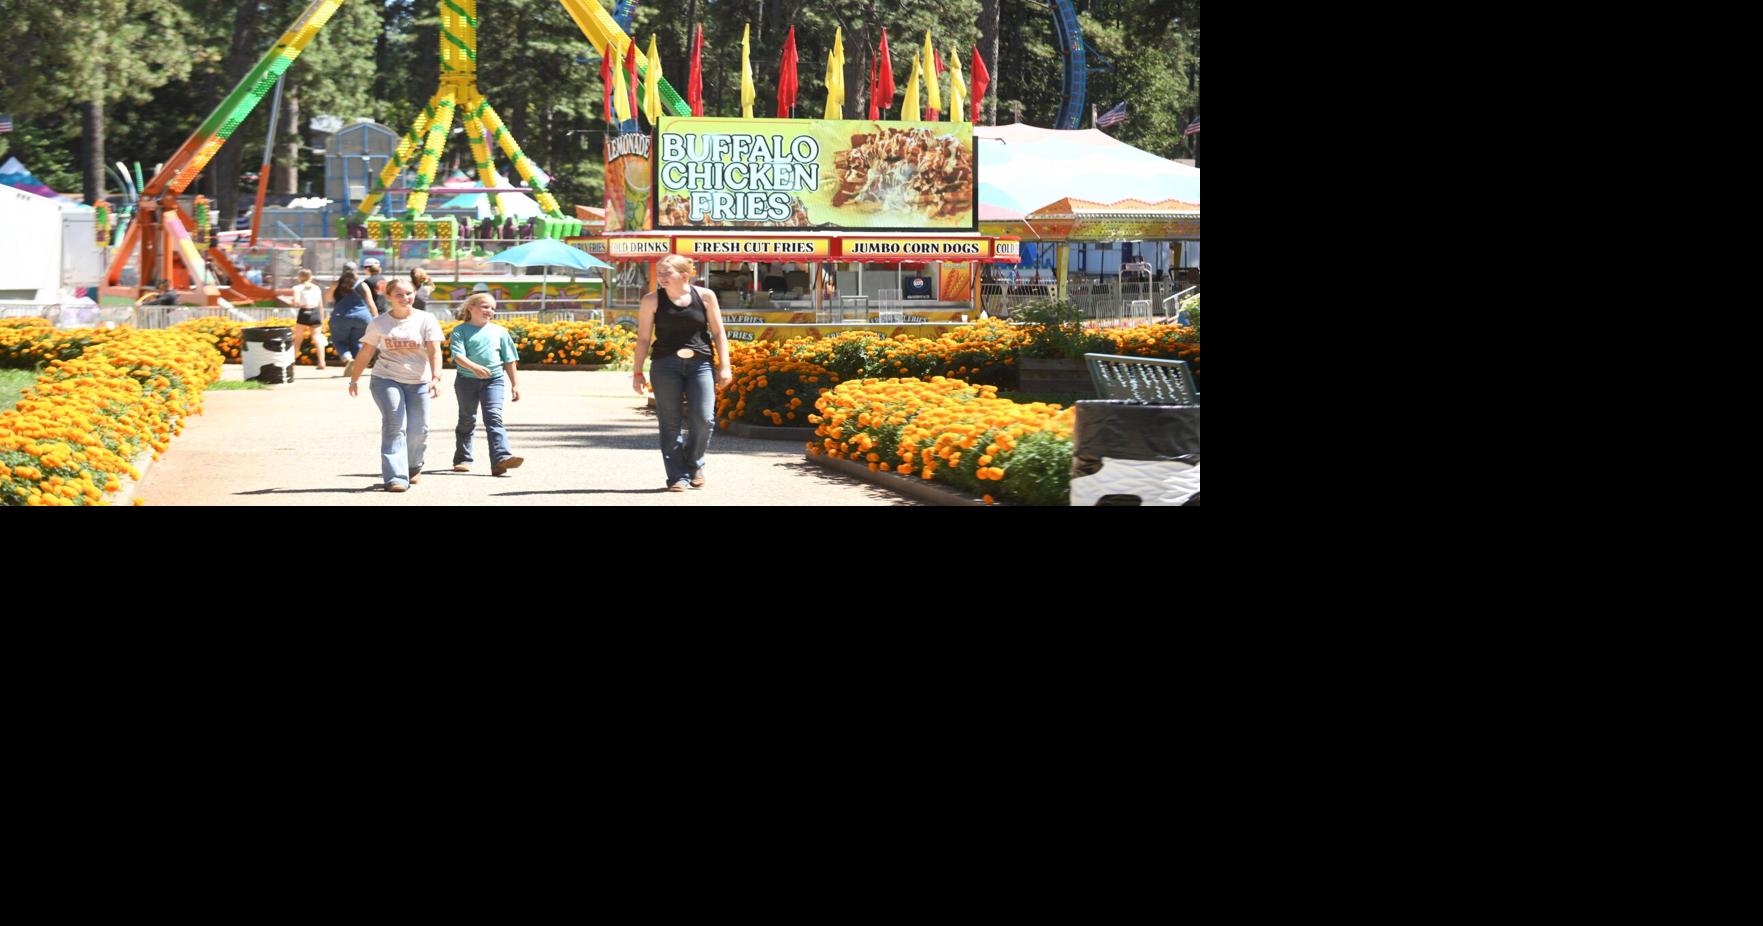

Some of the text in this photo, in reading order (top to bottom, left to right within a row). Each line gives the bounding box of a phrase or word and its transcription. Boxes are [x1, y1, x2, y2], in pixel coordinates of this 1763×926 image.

[608, 133, 650, 162] LEMONADE
[662, 133, 819, 163] BUFFALO
[661, 162, 819, 192] CHICKEN
[690, 191, 792, 222] FRIES
[630, 242, 669, 252] DRINKS
[694, 242, 814, 252] FRESH CUT FRIES
[852, 243, 980, 253] JUMBO CORN DOGS
[996, 243, 1015, 253] COLD
[738, 315, 764, 323] FRIES
[727, 330, 753, 340] FRIES
